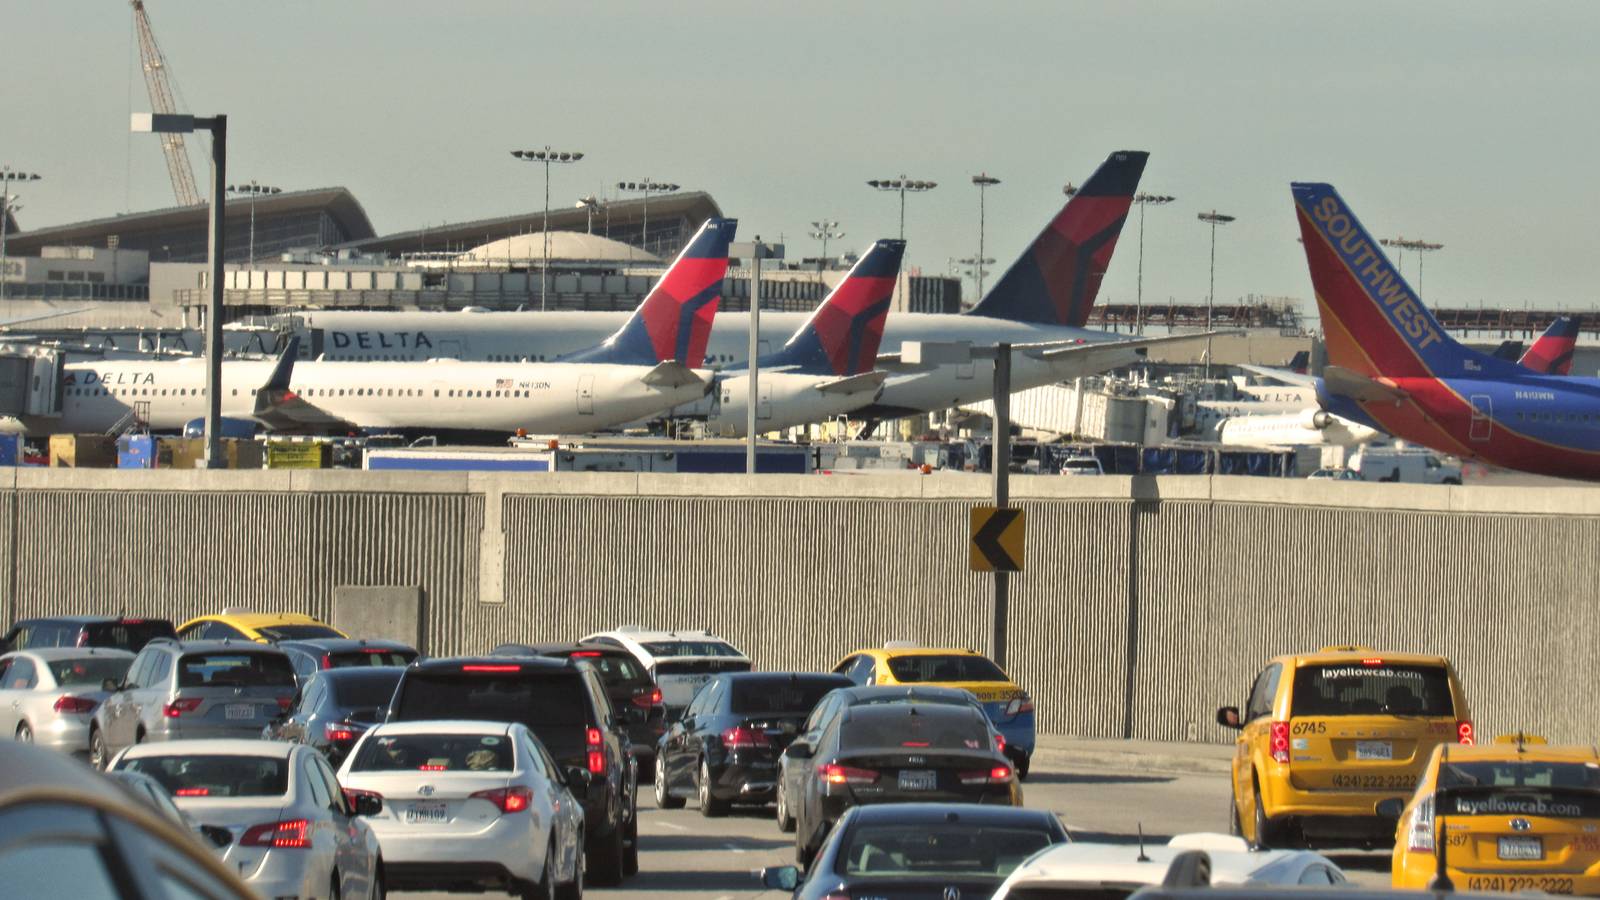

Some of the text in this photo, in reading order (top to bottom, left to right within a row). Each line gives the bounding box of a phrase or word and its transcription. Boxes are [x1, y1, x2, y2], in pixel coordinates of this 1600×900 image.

[1313, 197, 1442, 350] SOUTHWEST
[332, 331, 433, 349] DELTA
[84, 372, 155, 385] DELTA
[1322, 667, 1423, 680] layellowcab.com
[1292, 722, 1327, 735] 6745
[1363, 775, 1417, 787] 222-2222
[1456, 798, 1581, 815] layellowcab.com
